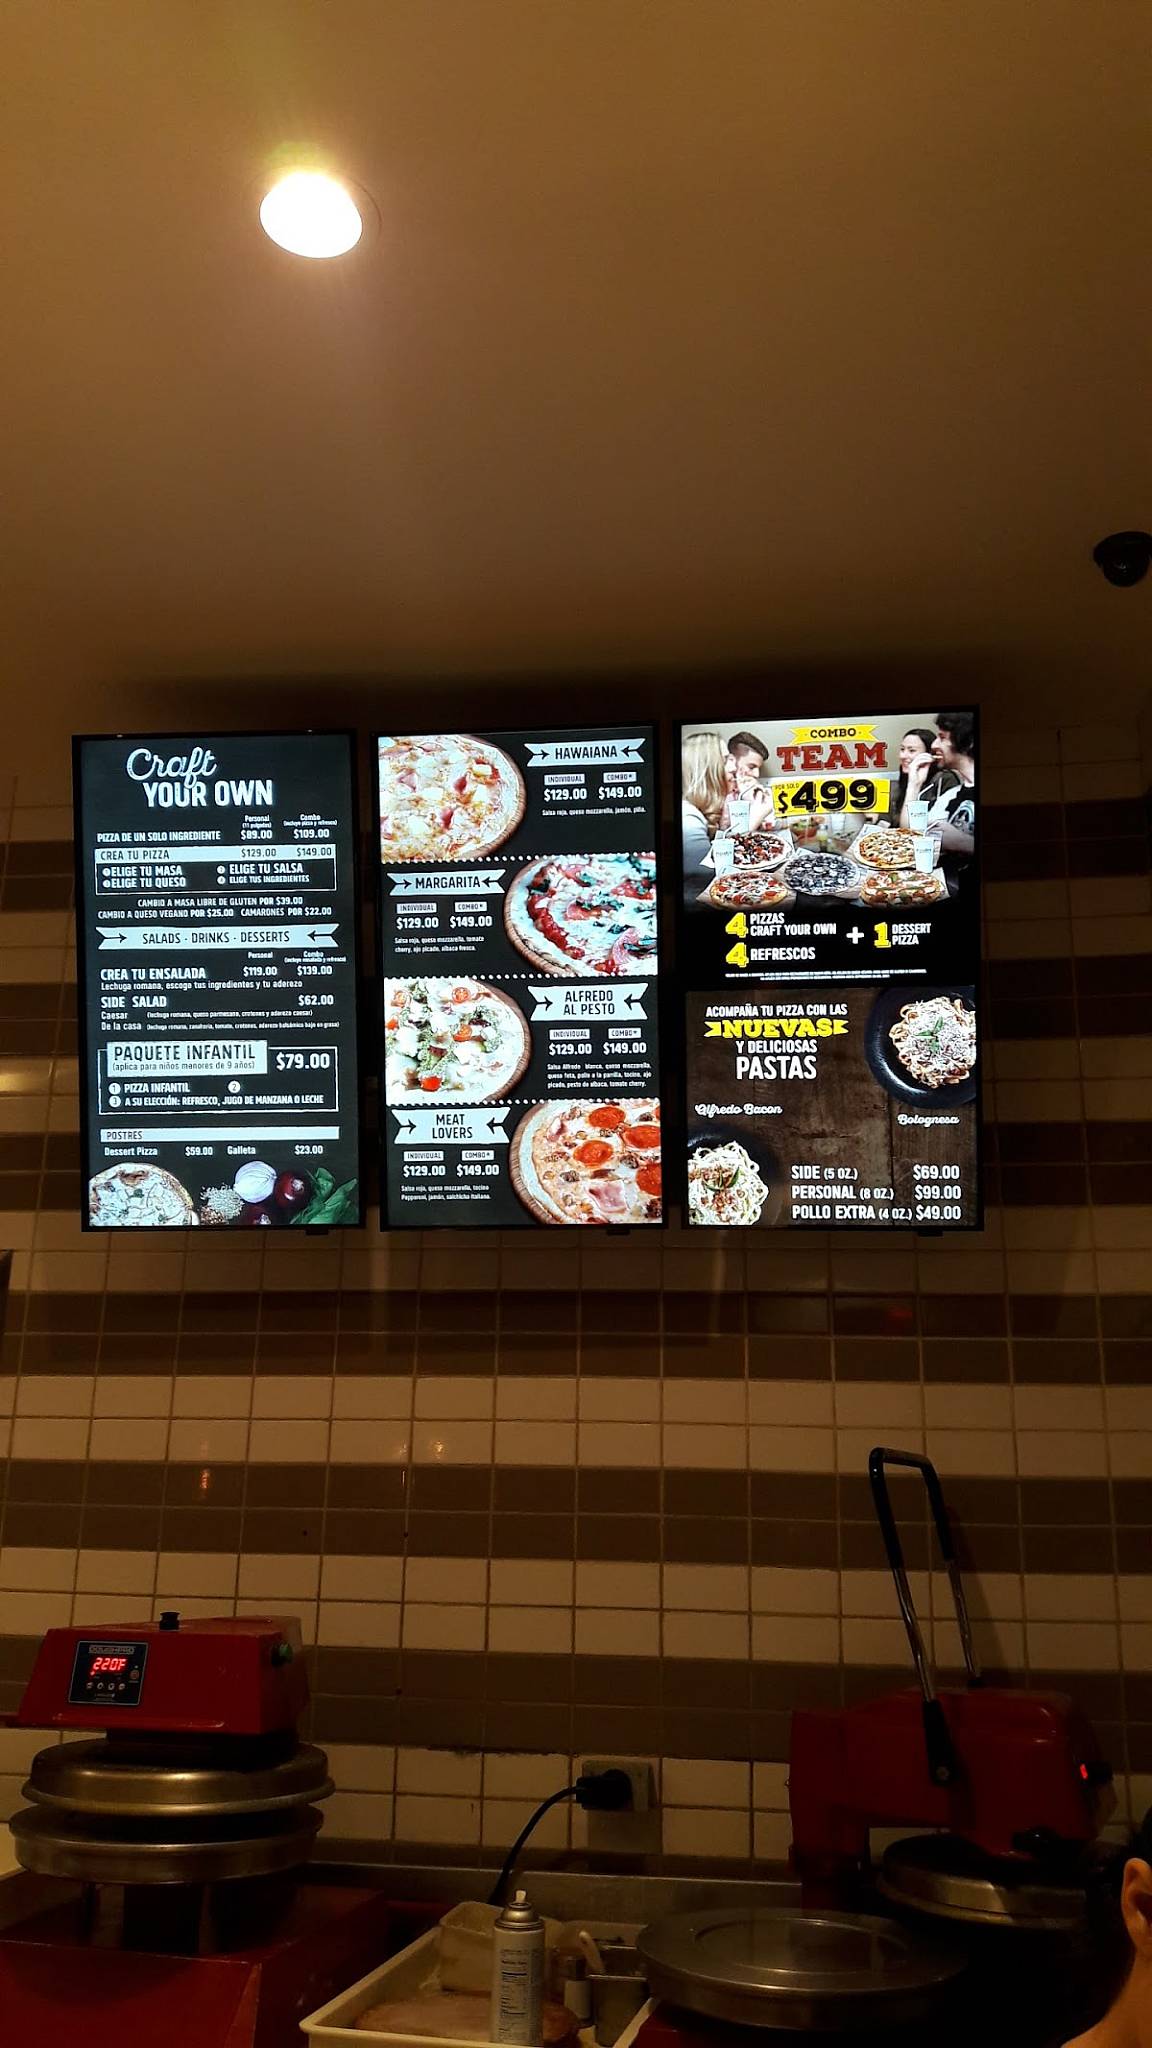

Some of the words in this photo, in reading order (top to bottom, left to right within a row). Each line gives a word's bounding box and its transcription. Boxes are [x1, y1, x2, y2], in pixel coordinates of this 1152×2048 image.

[810, 728, 856, 738] COMBO
[555, 746, 617, 760] HAWAIANA
[776, 742, 888, 772] TEAM
[127, 747, 217, 789] Craft
[548, 775, 582, 783] INDIVIDUAL
[143, 781, 207, 807] YOUR
[214, 780, 272, 806] OWN
[544, 788, 587, 802] $129.00
[598, 786, 642, 800] $149.00
[778, 779, 877, 814] $499
[97, 833, 120, 842] PIZZA
[122, 832, 132, 841] DE
[134, 832, 145, 841] UN
[148, 832, 167, 841] SOLO
[169, 831, 221, 840] INGREDIENTE
[240, 830, 272, 840] $89.00
[293, 829, 330, 839] $109.00
[100, 850, 124, 860] CREA
[128, 850, 139, 860] TU
[143, 850, 170, 859] PIZZA
[241, 848, 277, 858] $129.00
[296, 847, 332, 857] $149.00
[111, 866, 138, 876] ELIGE
[140, 866, 152, 876] TU
[155, 865, 183, 876] MASA
[229, 864, 256, 874] ELIGE
[258, 863, 271, 873] TU
[273, 863, 304, 873] SALSA
[111, 878, 138, 888] ELIGE
[140, 877, 152, 888] TU
[155, 877, 186, 888] QUESO
[229, 876, 248, 884] ELIGE
[250, 875, 262, 883] TUS
[263, 875, 310, 883] INGREDIENTES
[415, 876, 481, 889] MARGARITA
[137, 899, 165, 907] CAMBIO
[174, 898, 195, 906] MASA
[197, 898, 216, 906] LIBRE
[219, 898, 228, 906] DE
[230, 897, 257, 905] GLUTEN
[259, 897, 274, 905] POR
[276, 896, 303, 905] $39.00
[98, 911, 125, 919] CAMBIO
[134, 910, 157, 919] QUESO
[159, 909, 188, 918] VEGANO
[190, 909, 205, 917] POR
[207, 908, 234, 918] $25.00
[241, 908, 284, 916] CAMARONES
[288, 907, 302, 916] POR
[304, 907, 332, 916] $22.00
[750, 912, 785, 925] PIZZAS
[396, 917, 439, 930] $129.00
[449, 915, 493, 929] $149.00
[725, 912, 749, 938] 4
[892, 923, 931, 934] DESSERT
[750, 925, 782, 936] CRAFT
[784, 924, 811, 936] YOUR
[813, 923, 837, 935] OWN
[874, 922, 891, 948] 1
[143, 933, 181, 944] SALADS
[191, 932, 230, 943] DRINKS
[240, 931, 290, 943] DESSERTS
[892, 935, 919, 945] PIZZA
[725, 942, 749, 968] 4
[750, 947, 816, 960] REFRESCOS
[100, 969, 129, 980] CREA
[131, 968, 146, 980] TU
[149, 968, 206, 979] ENSALADA
[243, 966, 278, 977] $119.00
[297, 966, 333, 976] $139.00
[101, 982, 132, 992] Lechuga
[133, 983, 164, 991] romana,
[194, 981, 207, 989] tus
[208, 980, 254, 991] ingredientes
[255, 982, 261, 990] y
[262, 980, 271, 988] tu
[273, 980, 303, 988] aderezo
[100, 996, 126, 1009] SIDE
[132, 995, 167, 1008] SALAD
[298, 994, 334, 1006] $62.00
[565, 990, 613, 1002] ALFREDO
[101, 1011, 128, 1020] Caesar
[563, 1004, 577, 1015] AL
[581, 1003, 615, 1015] PESTO
[706, 1003, 759, 1017] ACOMPAÑA
[761, 1006, 773, 1016] TU
[776, 1005, 804, 1016] PIZZA
[806, 1004, 826, 1016] CON
[829, 1003, 848, 1015] LAS
[101, 1022, 111, 1031] De
[113, 1021, 121, 1030] la
[123, 1022, 142, 1031] casa
[722, 1018, 834, 1038] NUEVAS
[549, 1043, 592, 1056] $129.00
[603, 1042, 647, 1055] $149.00
[735, 1041, 745, 1053] Y
[748, 1039, 817, 1053] DELICIOSAS
[114, 1045, 181, 1062] PAQUETE
[187, 1044, 255, 1060] INFANTIL
[112, 1062, 138, 1072] (aplica
[140, 1062, 157, 1071] para
[159, 1061, 180, 1070] niños
[215, 1061, 224, 1070] de
[227, 1061, 232, 1070] 9
[234, 1061, 255, 1070] años)
[276, 1052, 330, 1071] $79.00
[736, 1055, 816, 1080] PASTAS
[124, 1083, 149, 1093] PIZZA
[151, 1082, 190, 1093] INFANTIL
[125, 1098, 131, 1106] A
[132, 1098, 142, 1106] SU
[144, 1095, 180, 1106] ELECCIÓN:
[182, 1096, 220, 1106] REFRESCO,
[222, 1096, 242, 1105] JUGO
[245, 1096, 254, 1104] DE
[255, 1095, 293, 1104] MANZANA
[294, 1095, 300, 1104] O
[301, 1095, 324, 1104] LECHE
[695, 1104, 742, 1118] Alfredo
[743, 1103, 782, 1115] Bacon
[436, 1114, 465, 1125] MEAT
[898, 1114, 960, 1127] Bolognesa
[107, 1131, 142, 1140] POSTRES
[432, 1127, 473, 1139] LOVERS
[104, 1147, 135, 1156] Dessert
[137, 1146, 158, 1155] Pizza
[185, 1146, 213, 1156] $59.00
[227, 1145, 256, 1155] Galleta
[294, 1144, 324, 1155] $23.00
[403, 1165, 446, 1178] $129.00
[457, 1164, 500, 1177] $149.00
[791, 1165, 820, 1180] SIDE
[824, 1168, 834, 1180] (5
[837, 1167, 858, 1180] OZ.)
[913, 1164, 960, 1181] $69.00
[792, 1185, 856, 1199] PERSONAL
[860, 1188, 870, 1200] (8
[874, 1188, 894, 1200] OZ.)
[915, 1184, 961, 1200] $99.00
[792, 1205, 831, 1219] POLLO
[835, 1204, 875, 1219] EXTRA
[878, 1208, 889, 1220] (4
[892, 1208, 912, 1220] OZ.)
[916, 1205, 961, 1220] $49.00
[93, 1657, 127, 1671] 220F
